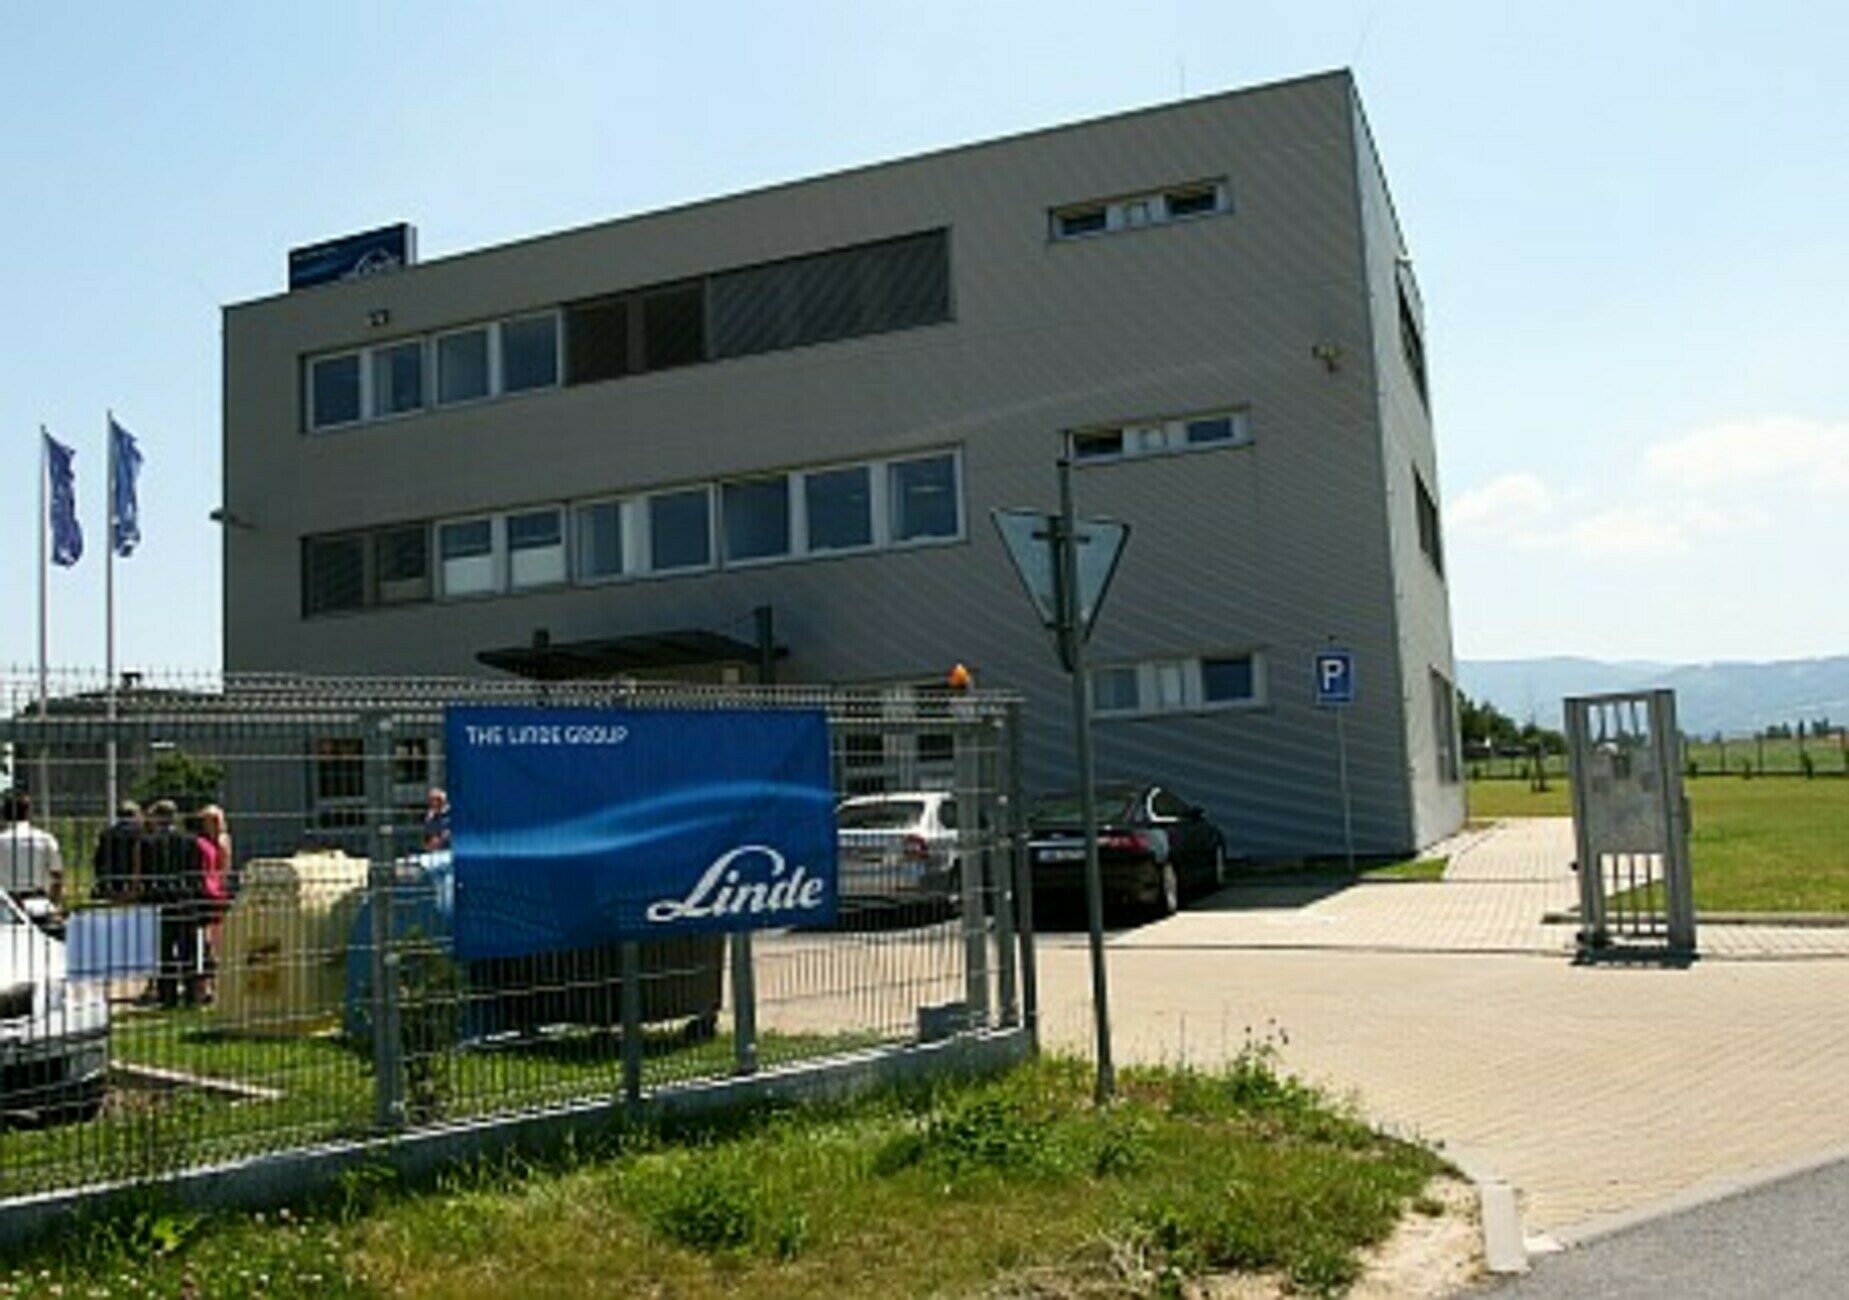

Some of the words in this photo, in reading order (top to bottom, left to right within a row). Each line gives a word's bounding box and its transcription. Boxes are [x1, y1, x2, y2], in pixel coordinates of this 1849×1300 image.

[1321, 660, 1345, 690] P
[465, 725, 503, 745] THE
[564, 725, 629, 744] GROUP
[647, 845, 823, 921] Linde
